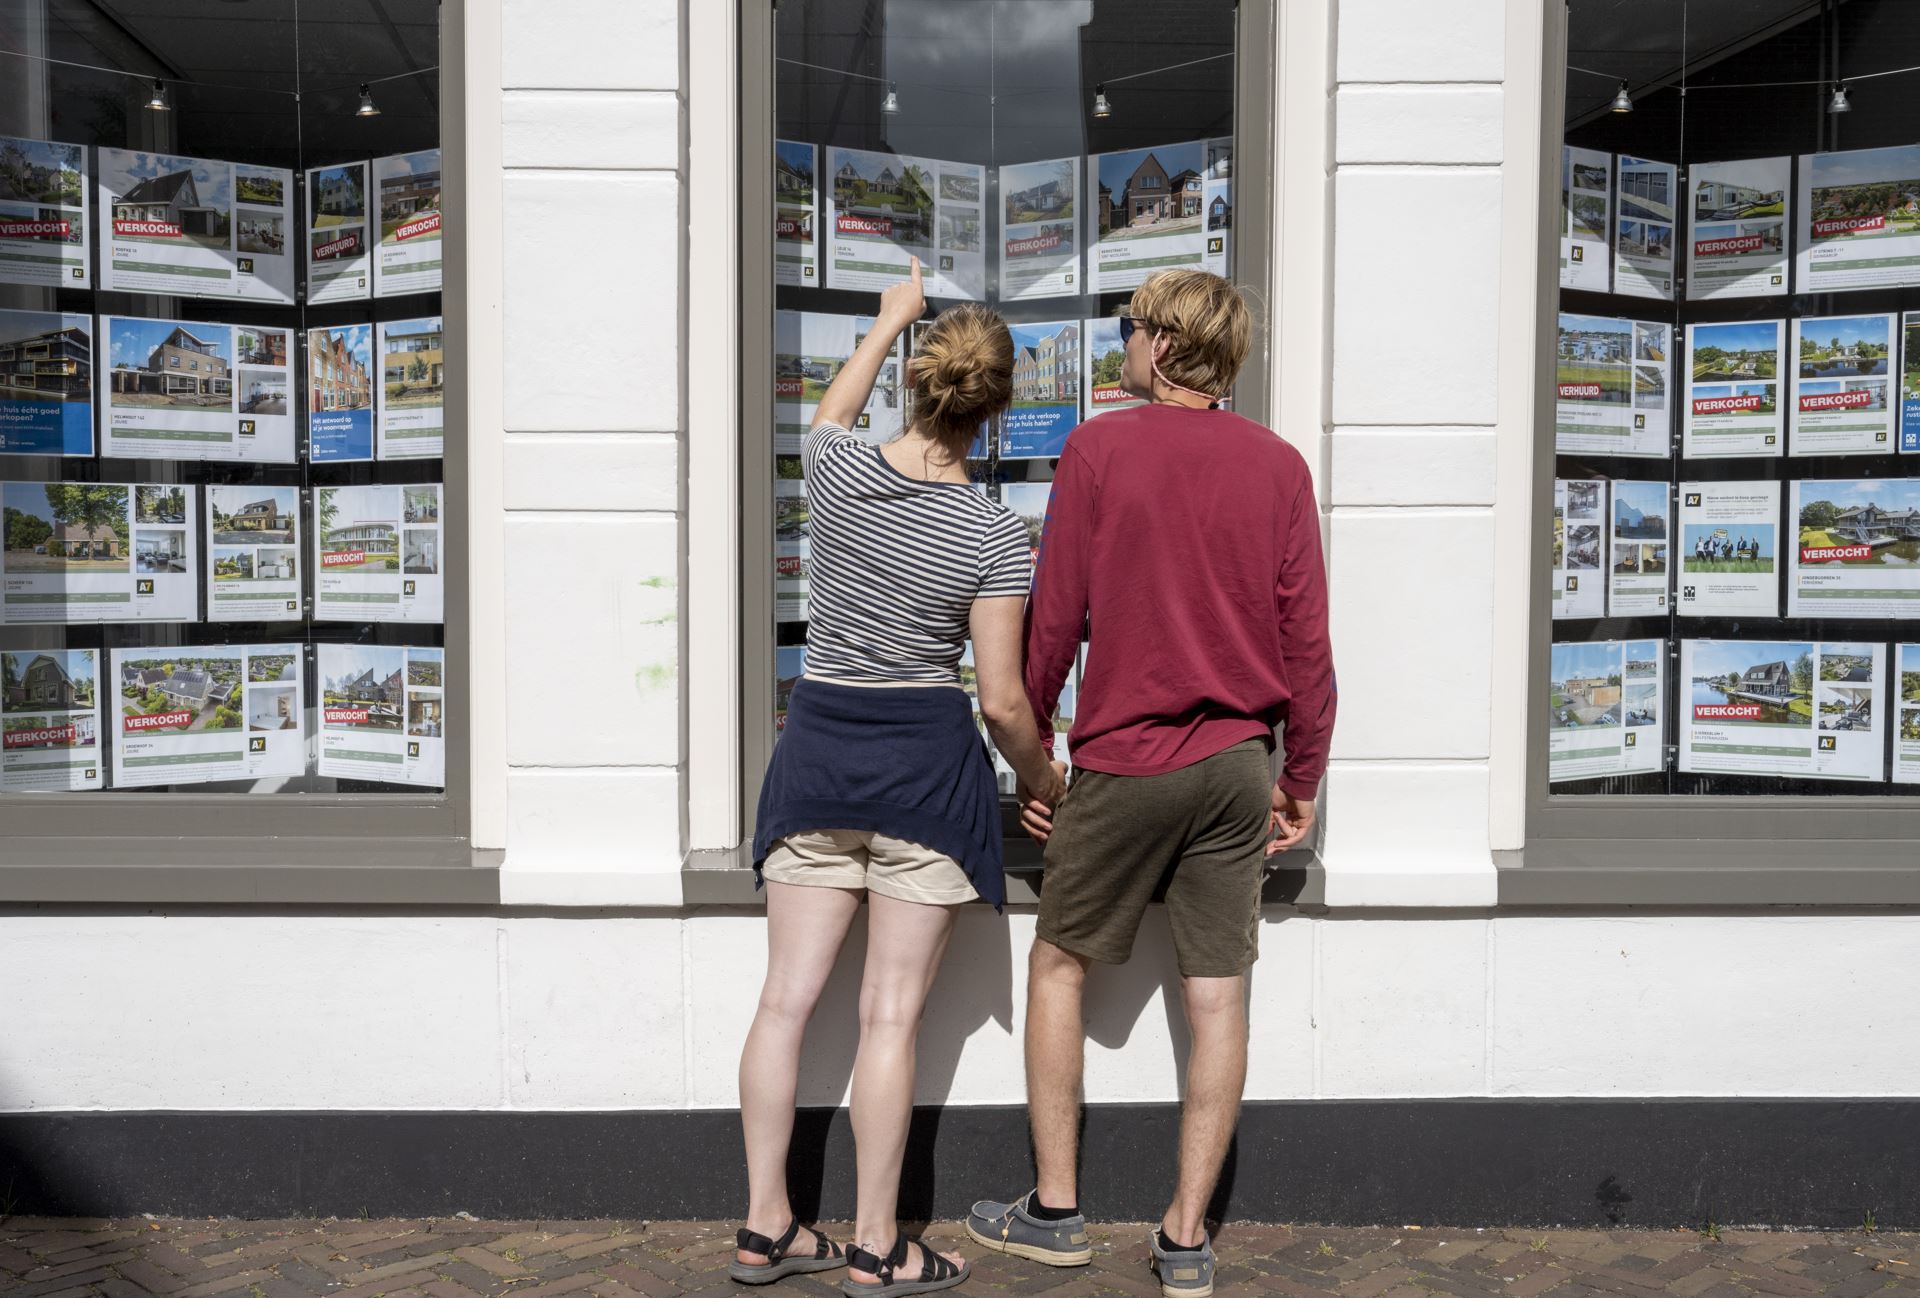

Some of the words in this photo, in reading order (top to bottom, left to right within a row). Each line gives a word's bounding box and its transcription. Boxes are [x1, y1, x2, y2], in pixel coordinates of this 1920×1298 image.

[0, 223, 68, 234] VERKOCHT
[117, 222, 181, 234] VERKOCHT
[397, 216, 440, 238] VERKOCHT
[838, 220, 891, 231] VERKOCHT
[1816, 216, 1883, 233] VERKOCHT
[316, 237, 355, 258] VERHUURD
[1008, 237, 1059, 253] VERKOCHT
[1697, 238, 1761, 252] VERKOCHT
[1094, 389, 1134, 400] VERKO
[1559, 386, 1599, 396] VERHUURD
[1695, 397, 1759, 411] VERKOCHT
[1802, 393, 1869, 408] VERKOCHT
[40, 407, 60, 416] goed
[1036, 412, 1061, 420] verkoop
[1687, 495, 1700, 505] A7
[323, 553, 364, 564] VERKOCHT
[1803, 547, 1870, 559] VERKOCHT
[326, 711, 368, 721] VERKOCHT
[1696, 707, 1759, 716] VERKOCHT
[126, 713, 190, 728] VERKOCHT
[6, 728, 73, 743] VERKOCHT
